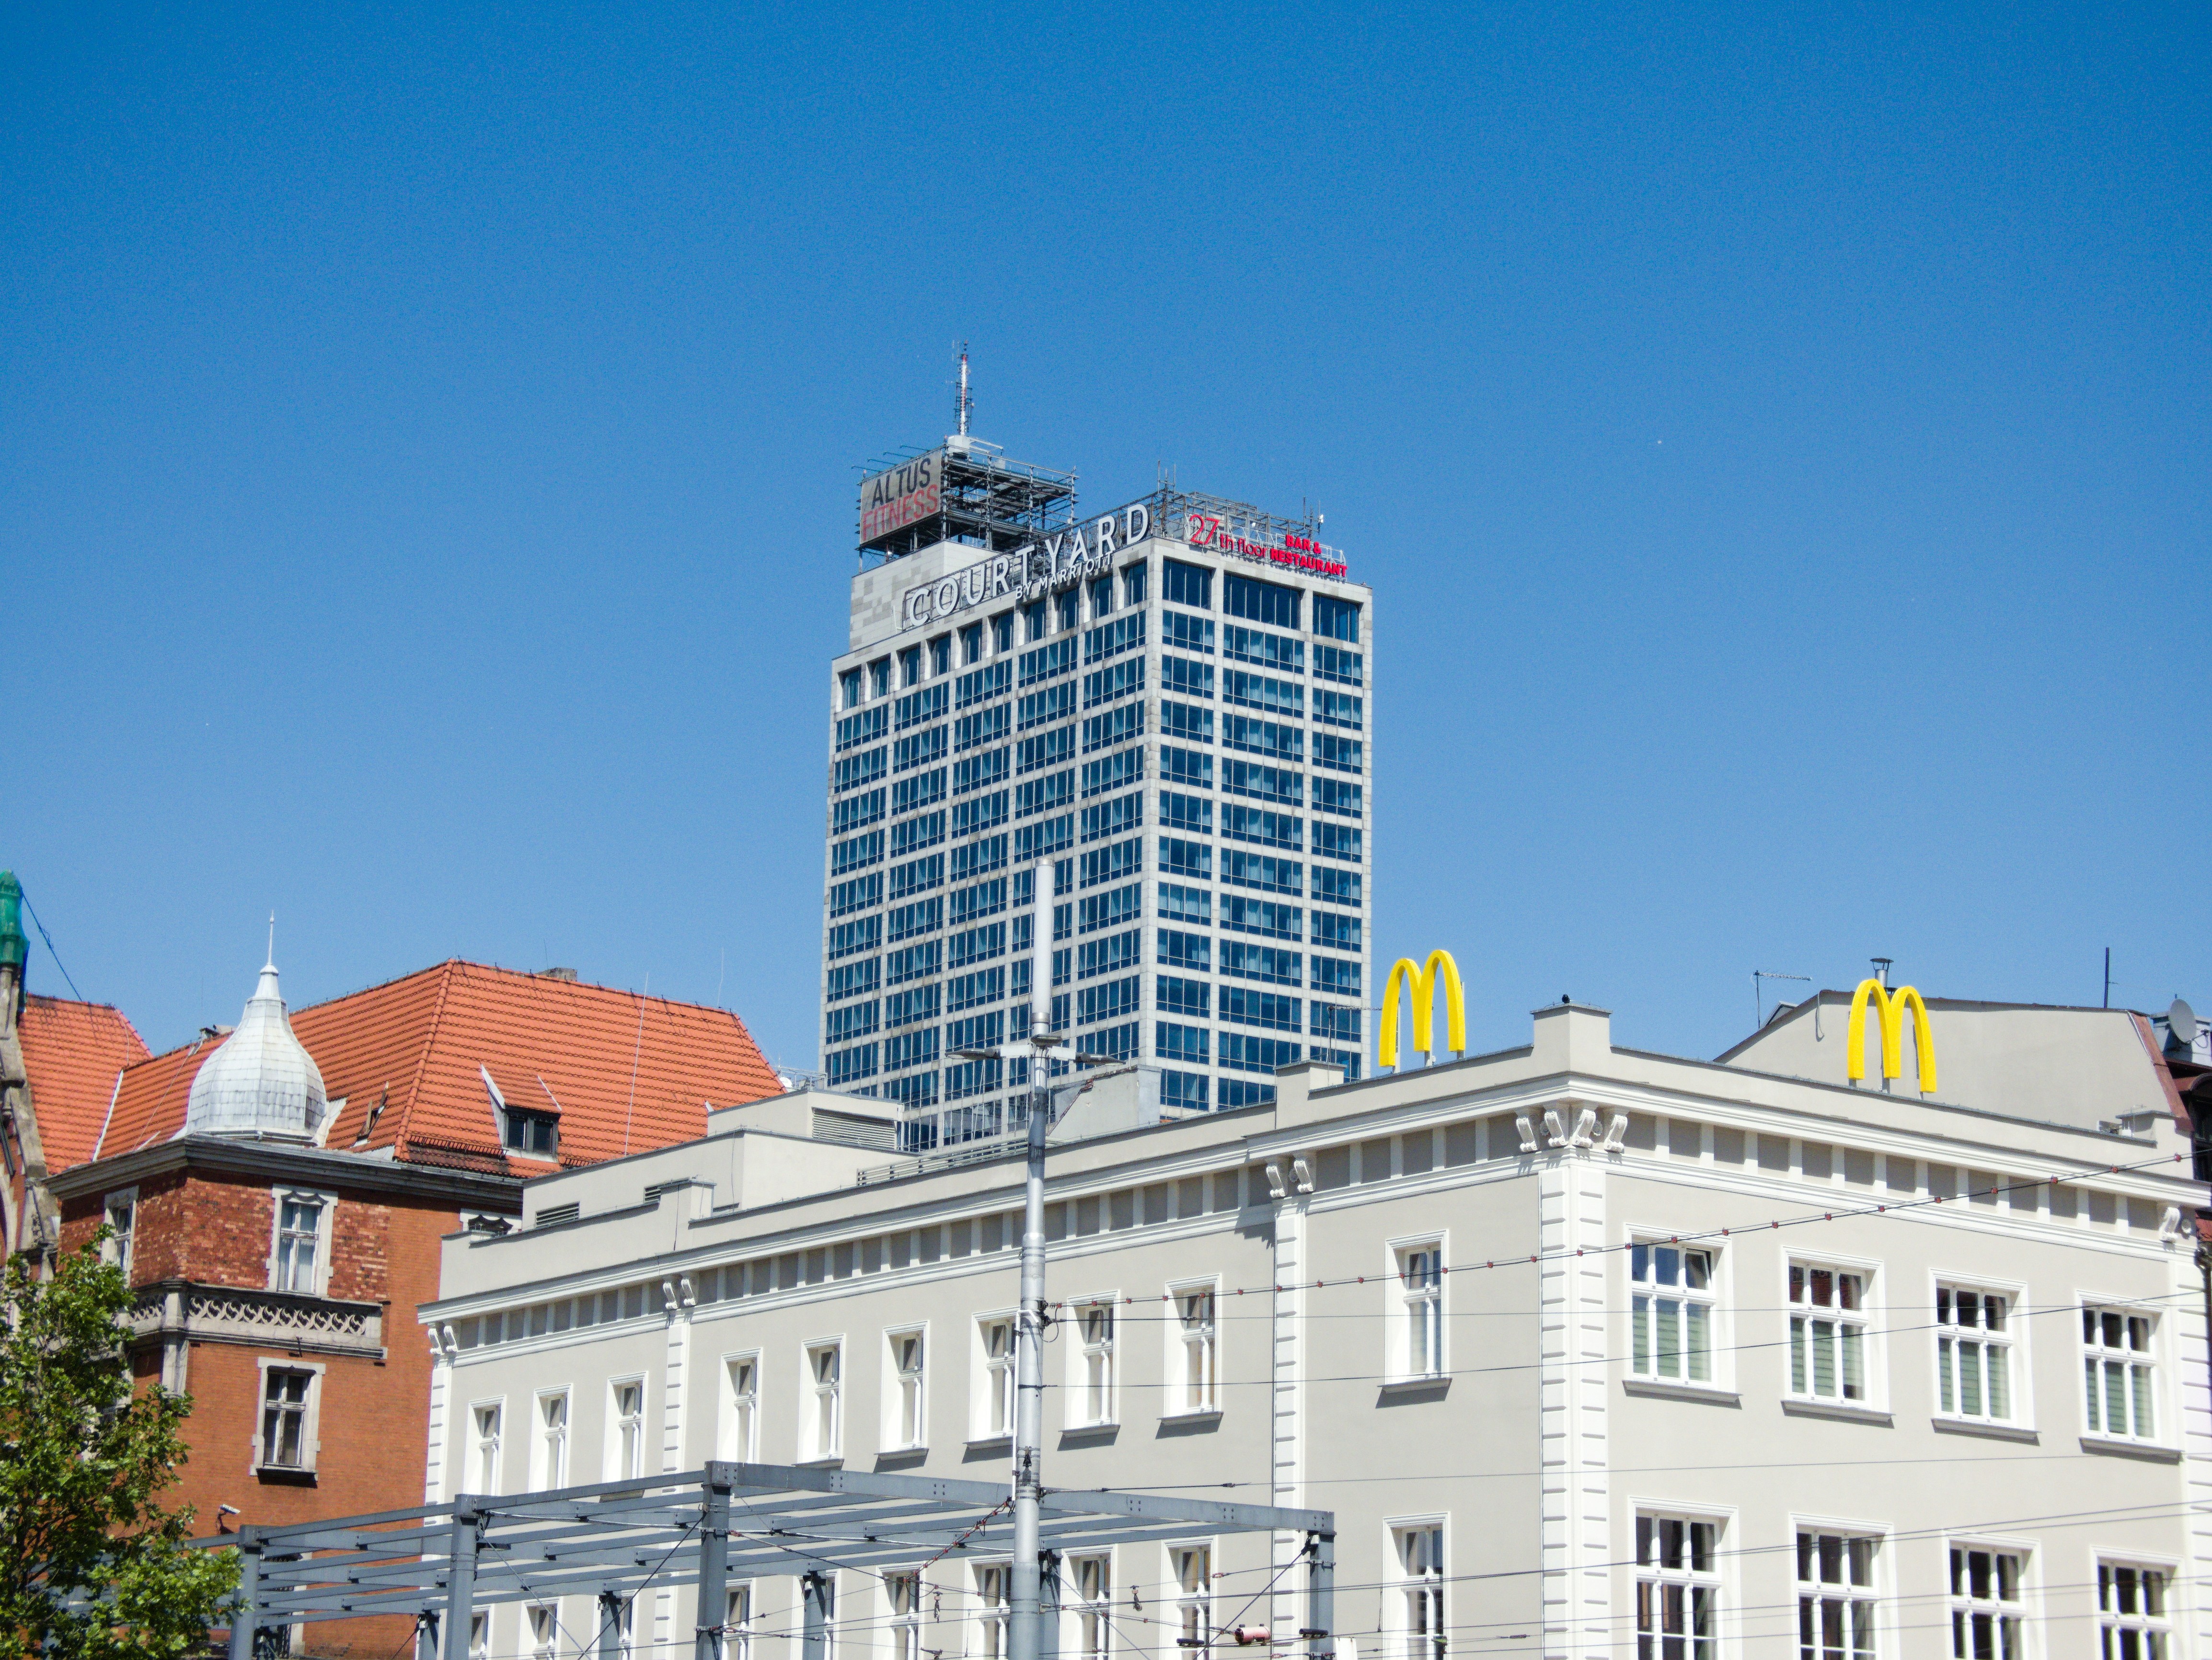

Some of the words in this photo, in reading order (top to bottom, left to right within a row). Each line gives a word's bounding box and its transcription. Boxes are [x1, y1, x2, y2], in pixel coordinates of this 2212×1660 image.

[872, 458, 931, 509] ALTUS
[863, 484, 937, 541] FITNESS
[910, 504, 1148, 626] COURTYARD
[1238, 538, 1267, 558] floor
[1270, 548, 1348, 577] RESTAURANT
[1286, 534, 1310, 551] BAR
[1313, 542, 1321, 554] &
[1016, 581, 1032, 599] BY
[1039, 551, 1113, 590] MARRIOTT
